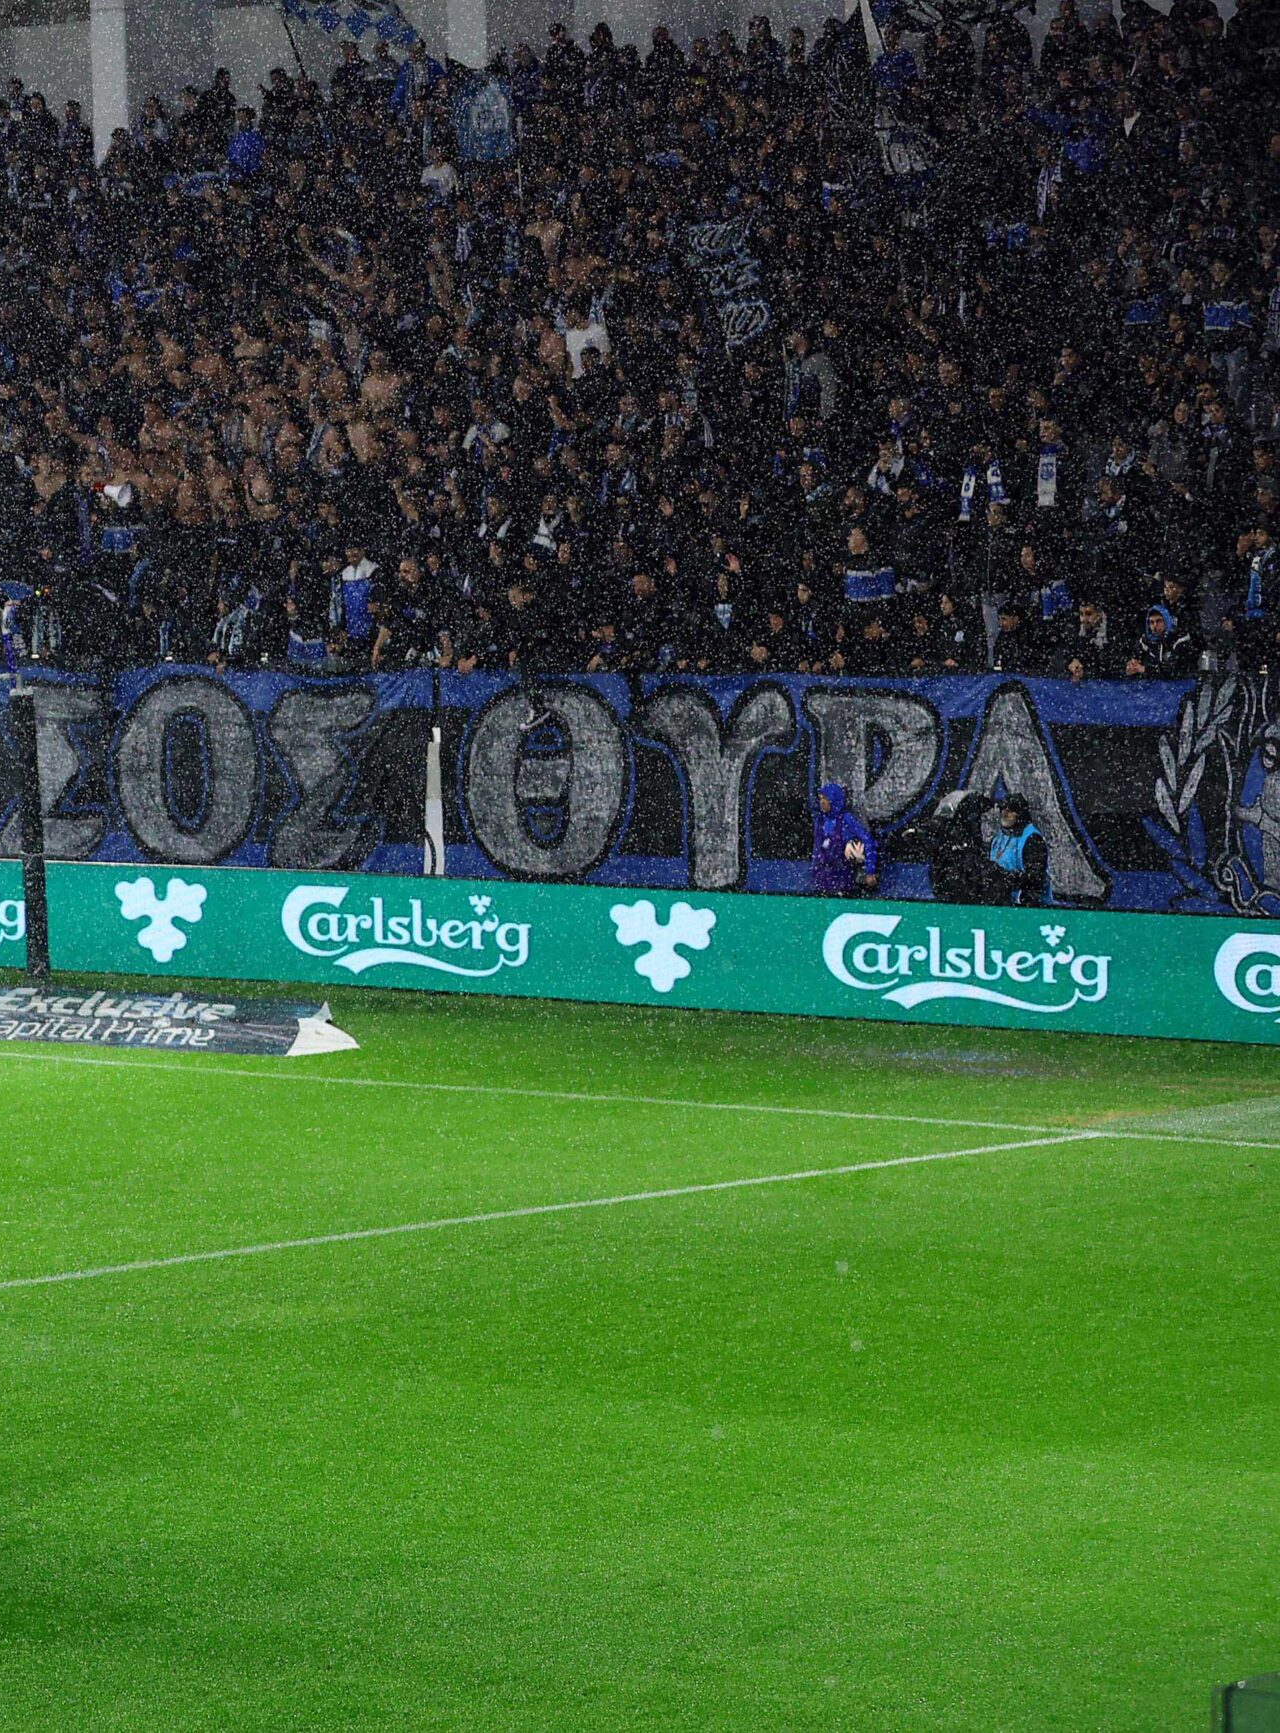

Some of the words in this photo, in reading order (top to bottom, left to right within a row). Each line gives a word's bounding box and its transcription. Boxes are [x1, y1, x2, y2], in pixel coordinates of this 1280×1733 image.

[281, 885, 531, 973] Carlsberg
[822, 912, 1112, 1009] Carlsberg
[101, 1019, 215, 1047] Prime
